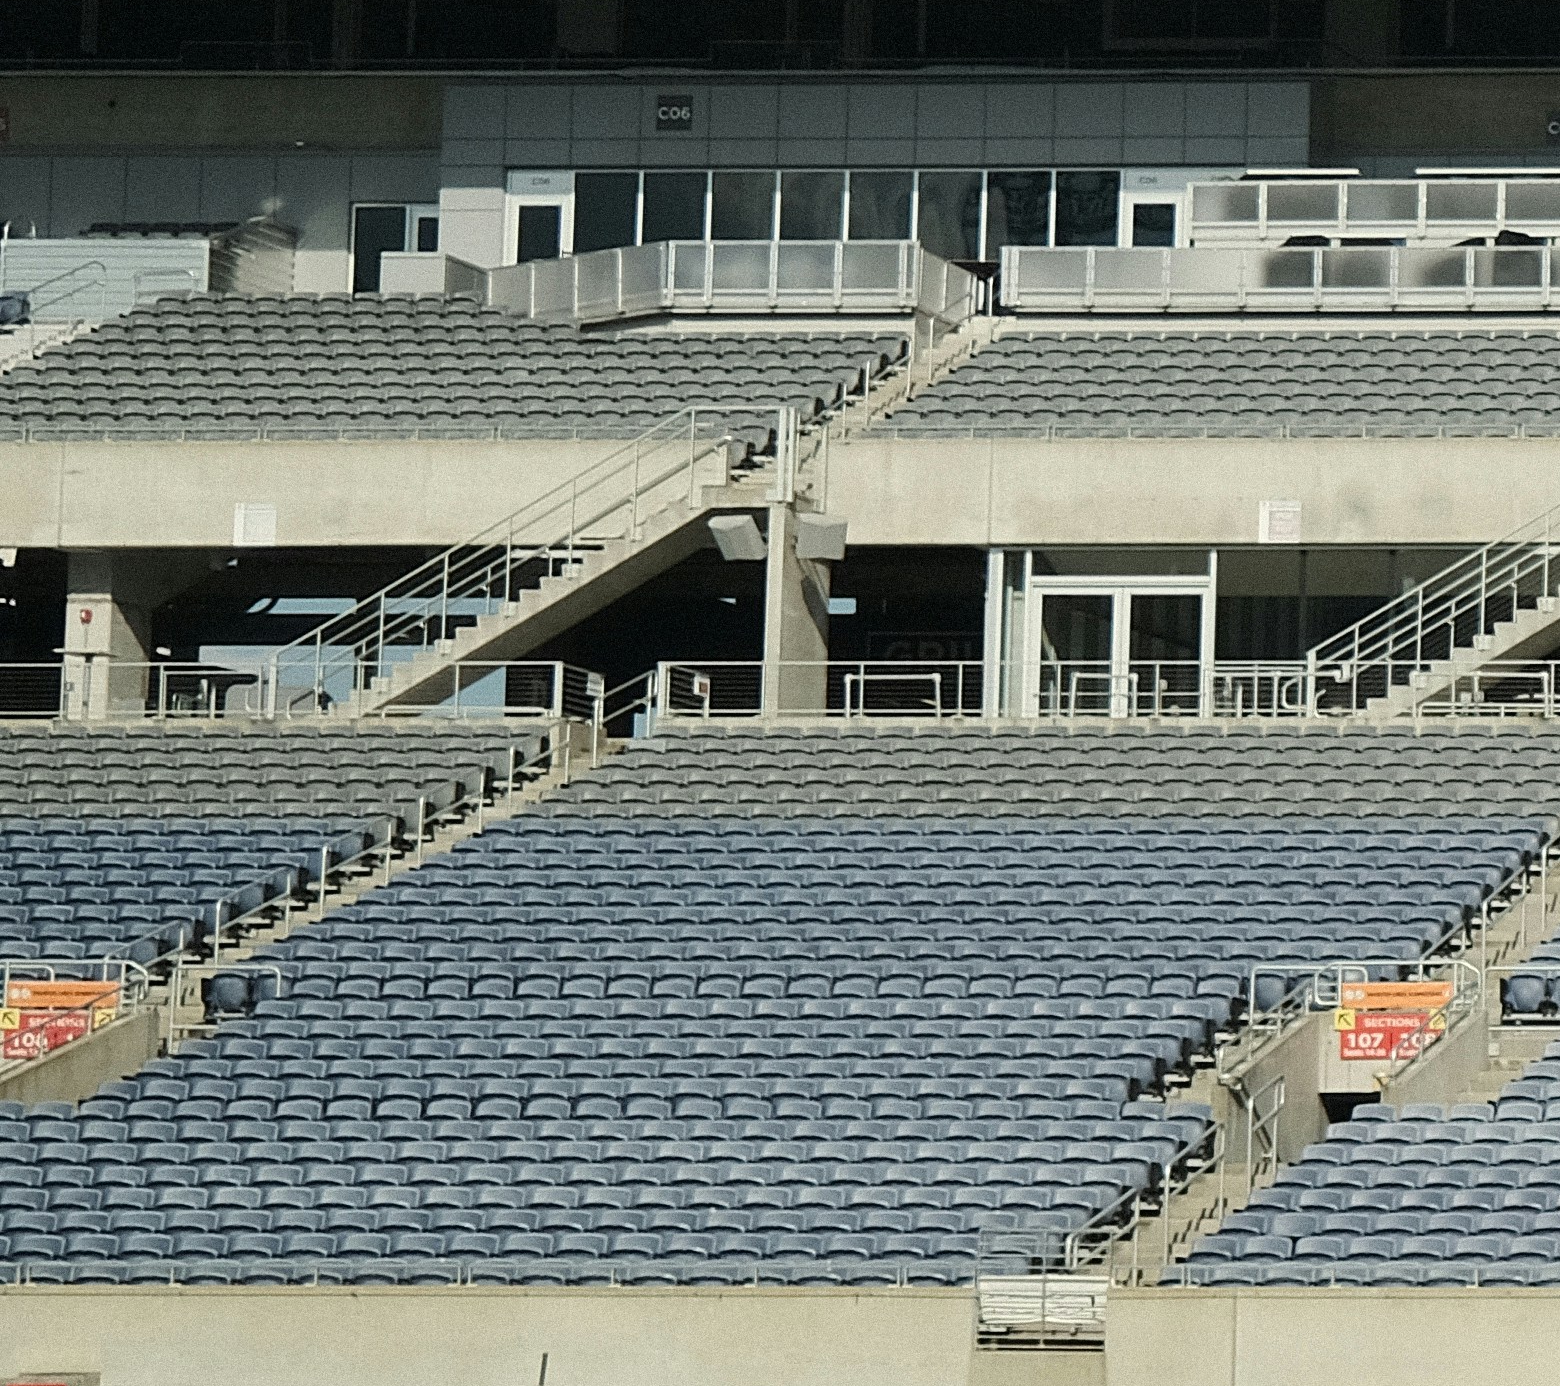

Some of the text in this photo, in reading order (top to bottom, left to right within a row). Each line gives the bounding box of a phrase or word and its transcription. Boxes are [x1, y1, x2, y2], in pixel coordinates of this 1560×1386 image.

[658, 107, 691, 120] C06
[1364, 1018, 1421, 1027] SECTIONS
[1347, 1033, 1384, 1048] 107
